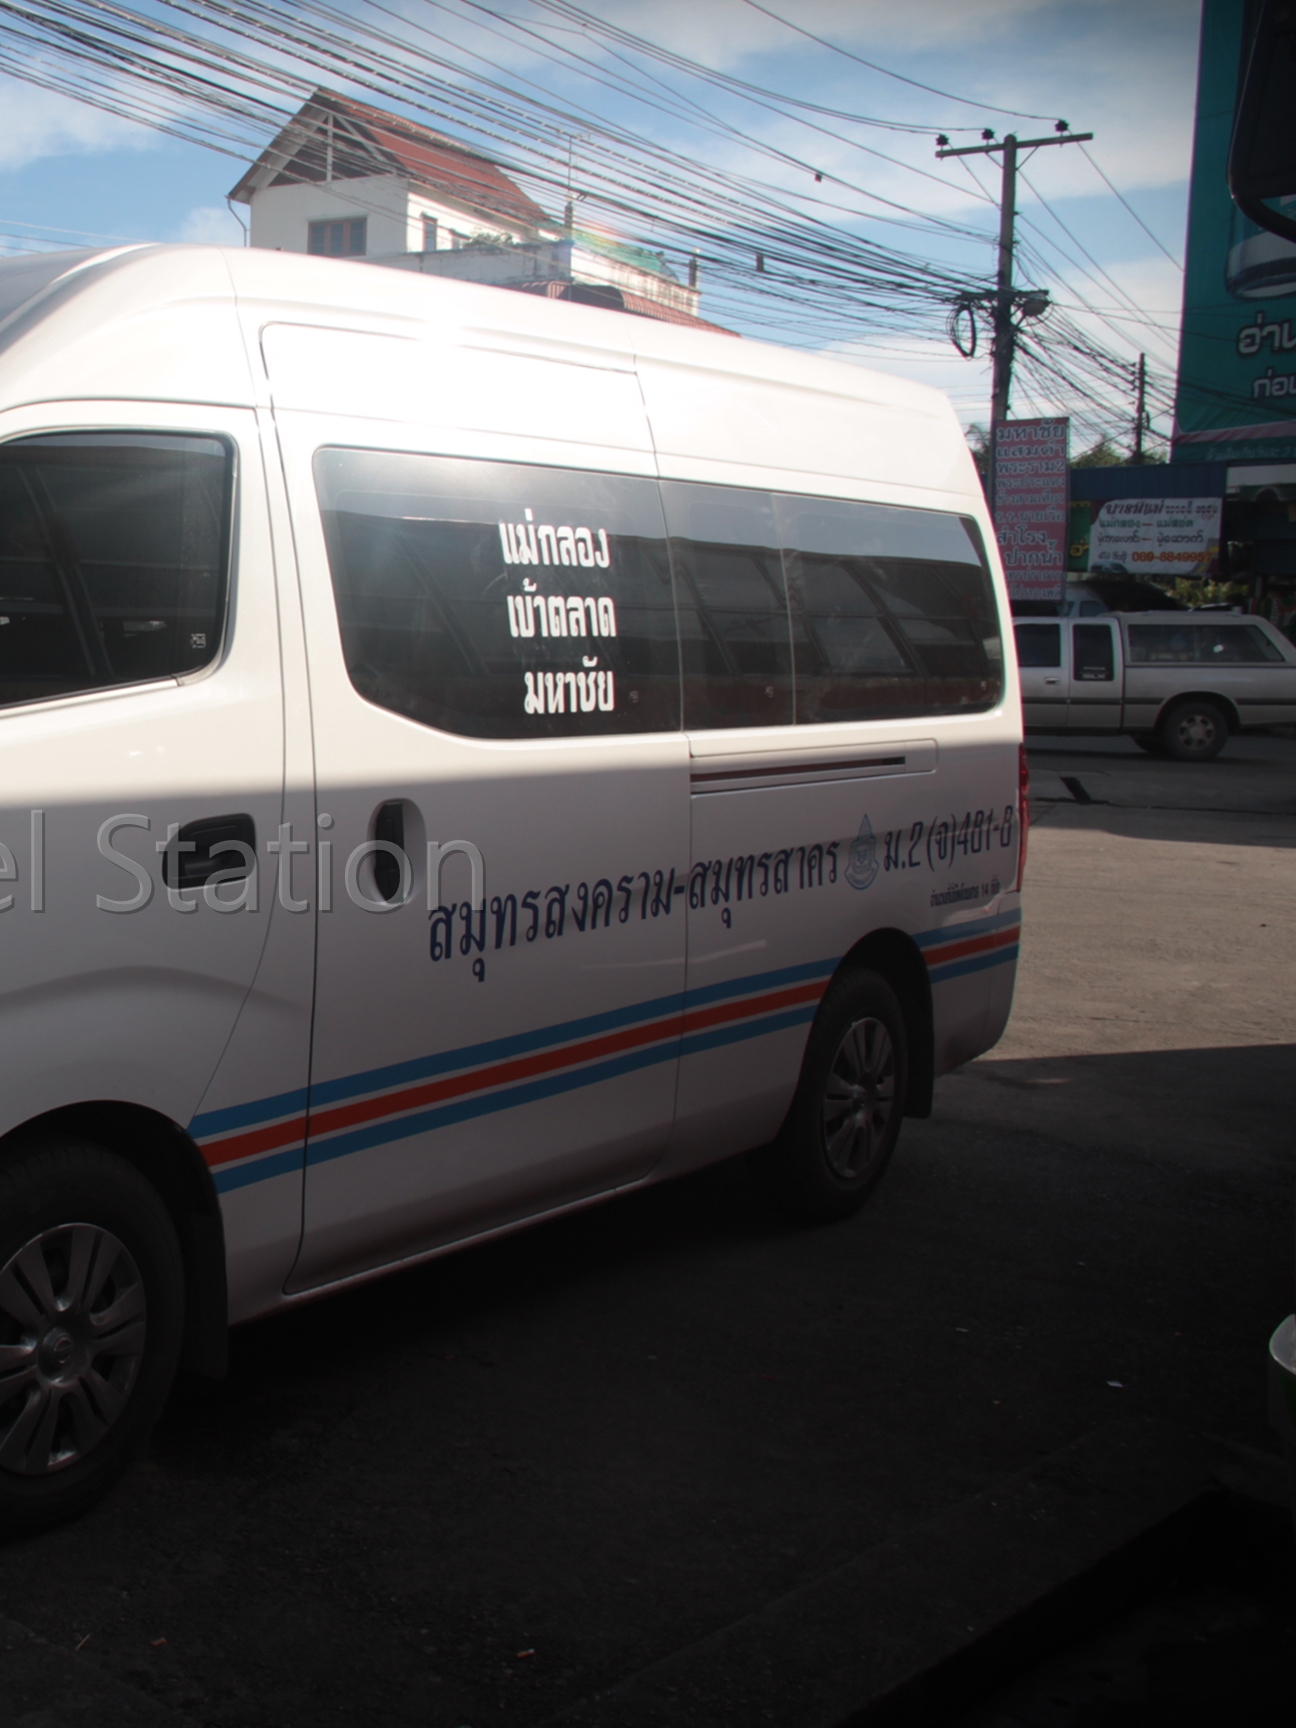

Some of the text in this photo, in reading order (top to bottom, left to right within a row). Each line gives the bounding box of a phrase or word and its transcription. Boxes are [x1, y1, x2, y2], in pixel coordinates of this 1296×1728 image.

[996, 418, 1065, 441] มหาชัย
[996, 440, 1065, 458] แสมดำ
[499, 508, 610, 568] แม่กลอง
[997, 524, 1048, 545] สำโรง
[1004, 540, 1063, 566] ปากน้ำ
[507, 577, 617, 638] เข้าตลาด
[523, 655, 615, 714] มหาชัย
[428, 841, 841, 983] สมุทรสงคราม-สมุทรสาคร
